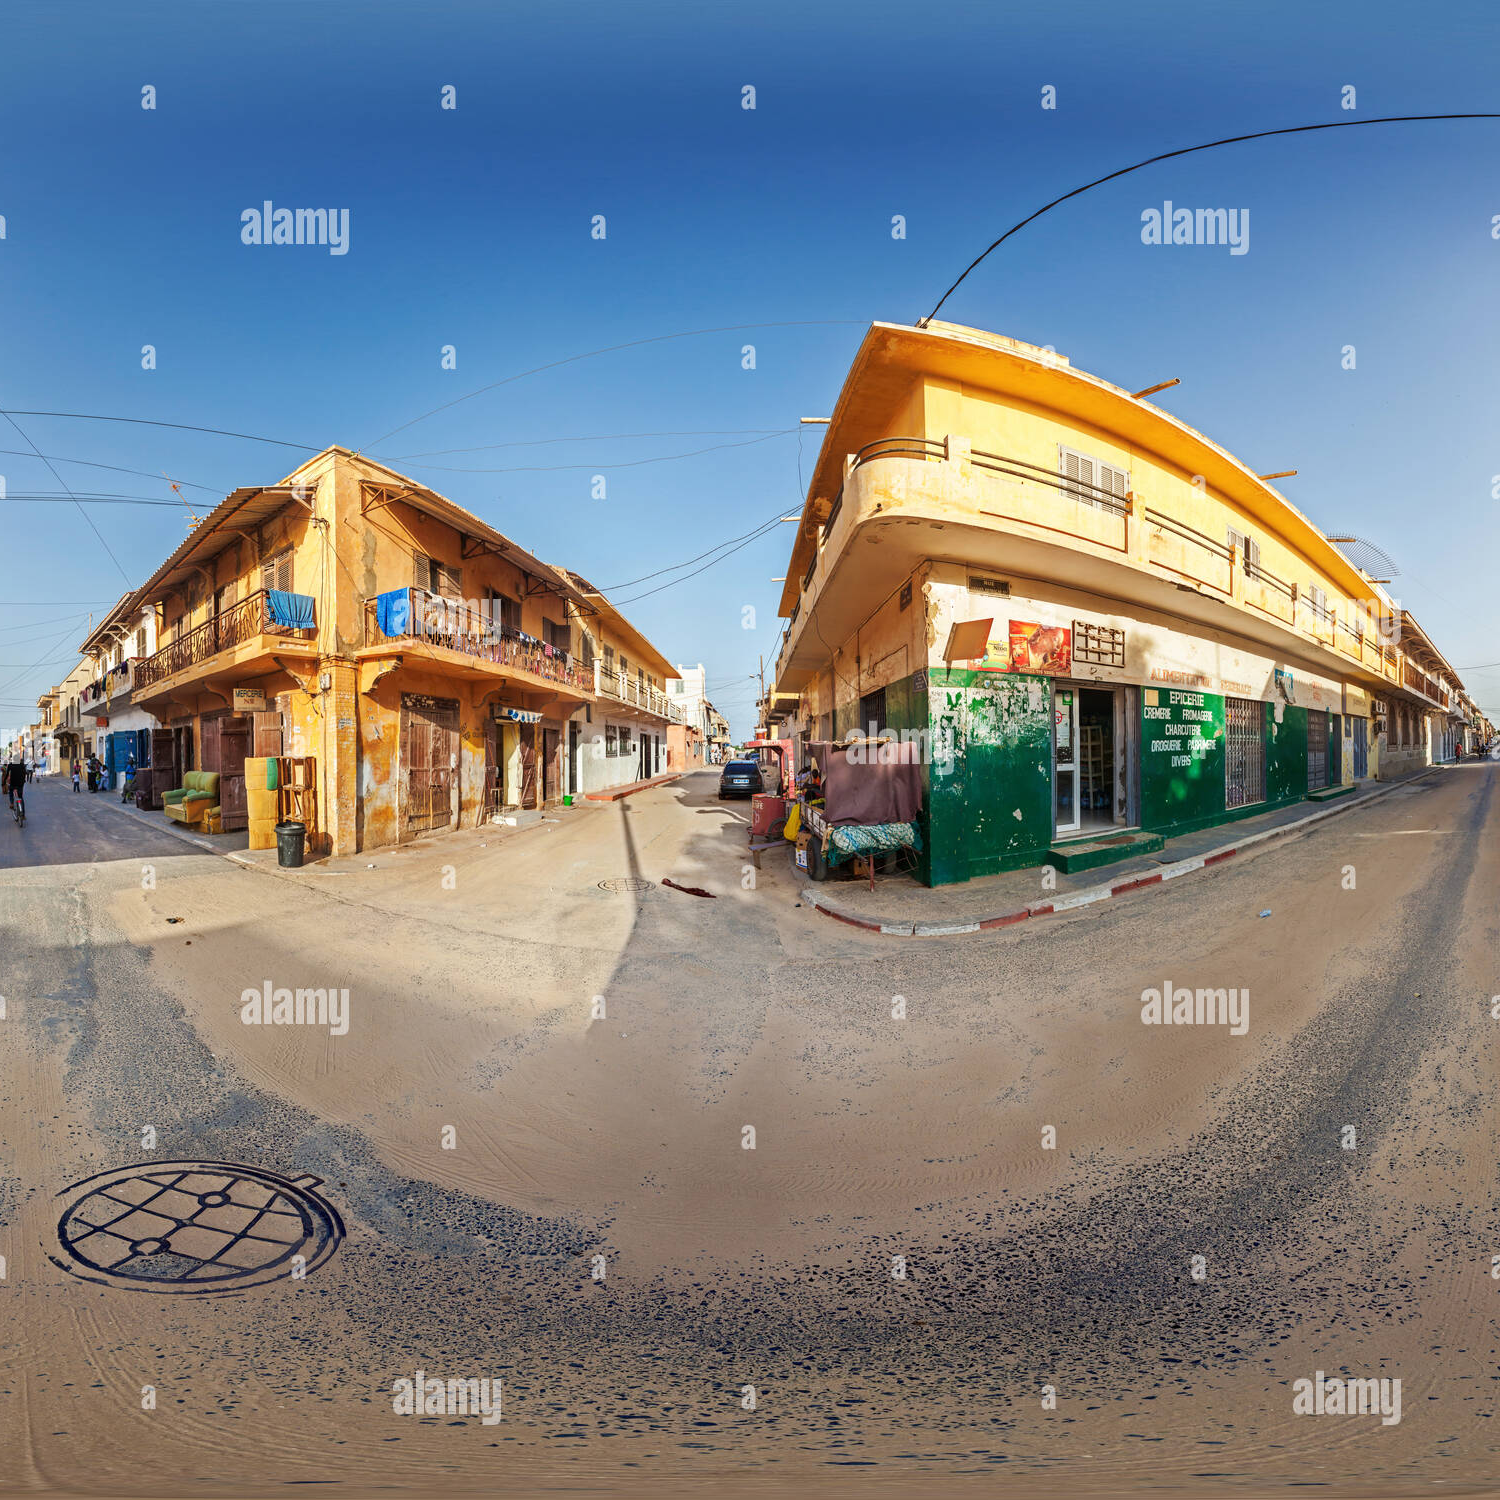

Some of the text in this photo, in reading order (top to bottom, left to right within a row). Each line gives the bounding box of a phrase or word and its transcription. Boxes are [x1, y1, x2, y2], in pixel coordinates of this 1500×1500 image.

[1169, 690, 1204, 706] EPICERIE
[1143, 707, 1213, 721] CREMERIE FROMAGERIE
[1171, 755, 1192, 767] DIVERS
